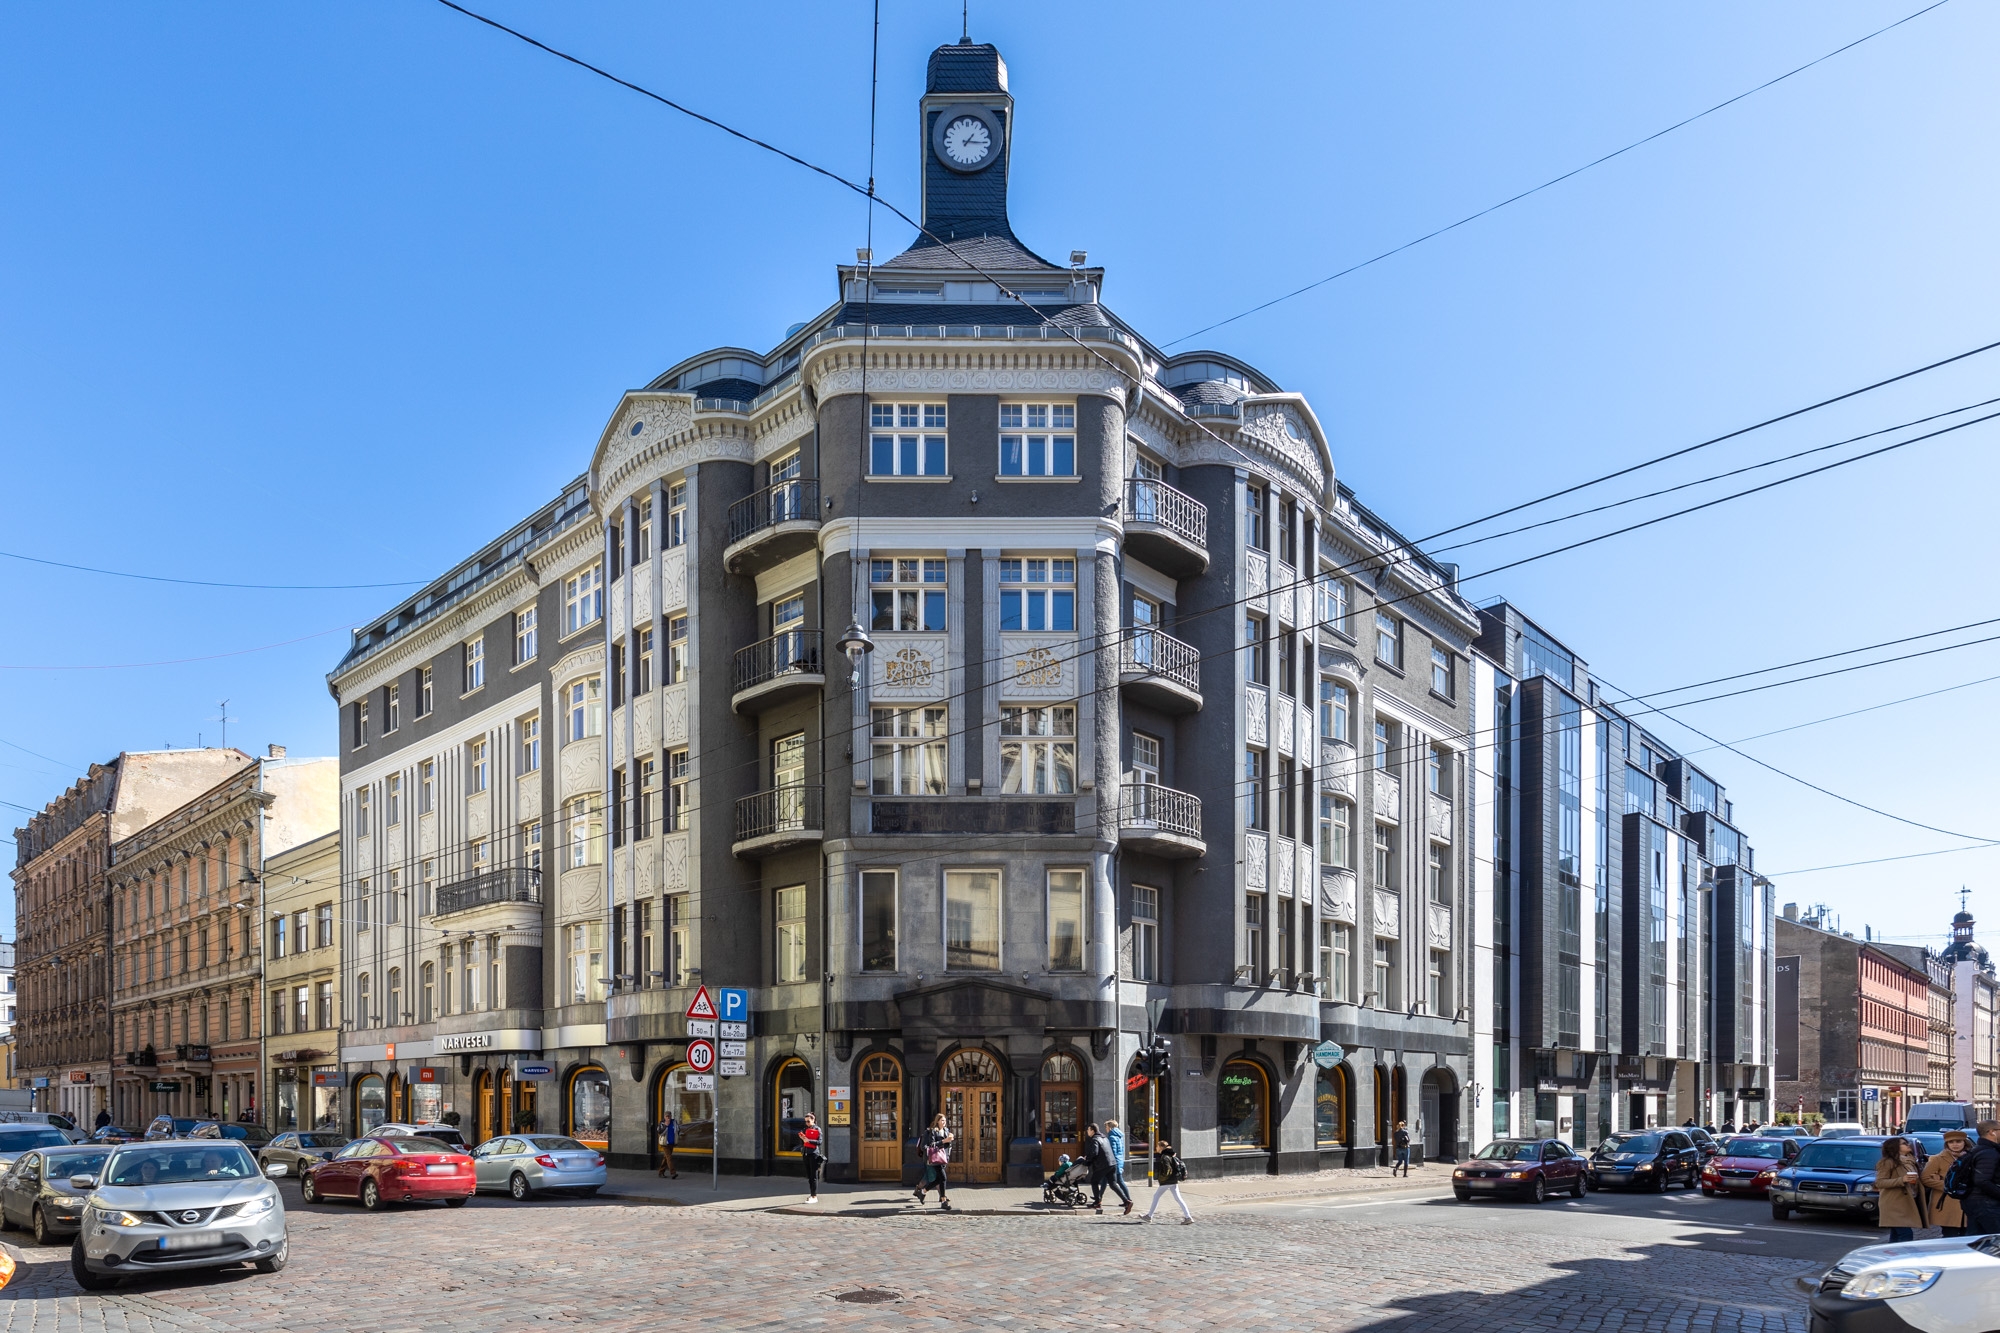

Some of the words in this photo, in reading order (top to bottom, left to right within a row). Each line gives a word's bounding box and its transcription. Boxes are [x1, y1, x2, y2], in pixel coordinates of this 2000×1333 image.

[727, 993, 741, 1016] P
[441, 1035, 488, 1050] NARVESEN
[694, 1049, 708, 1064] 30
